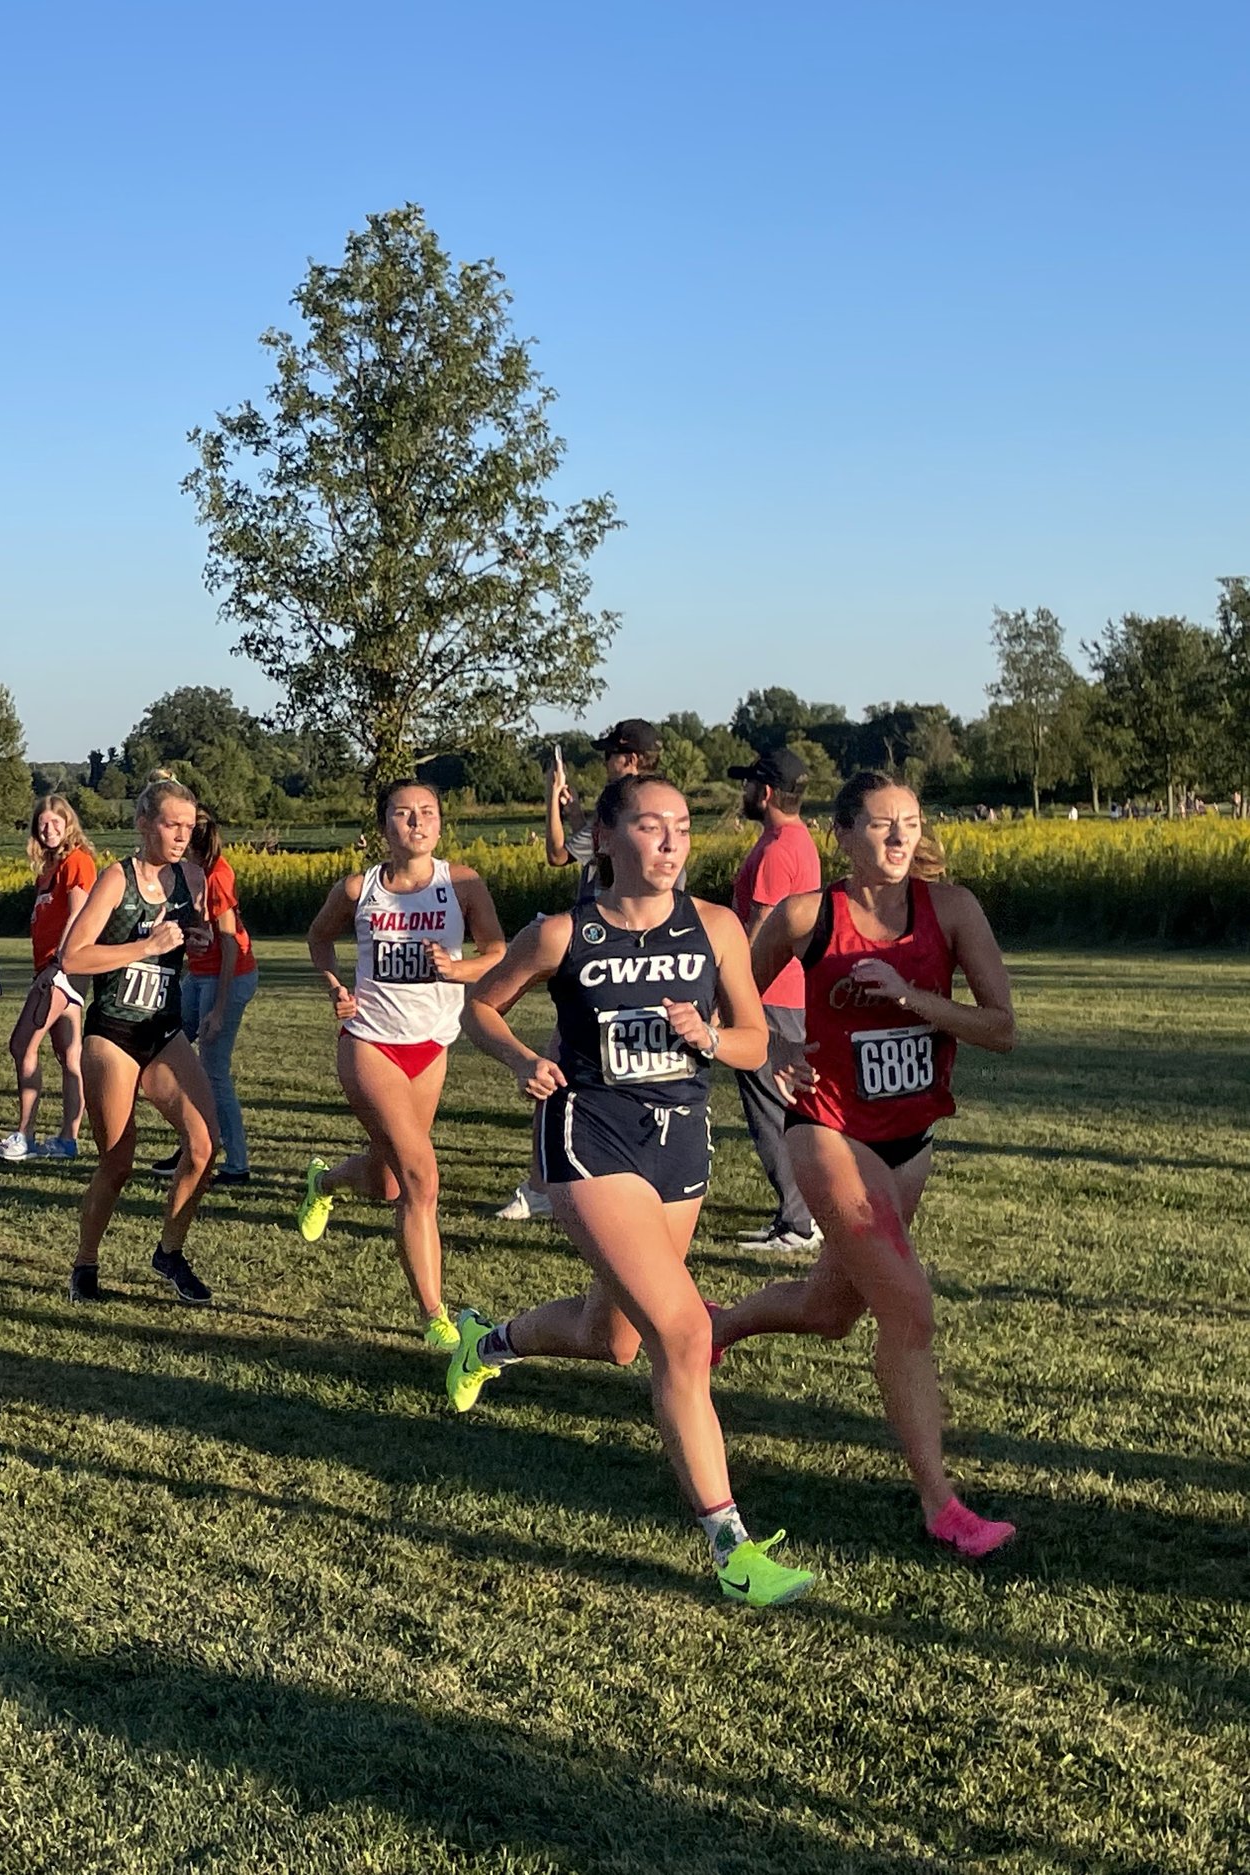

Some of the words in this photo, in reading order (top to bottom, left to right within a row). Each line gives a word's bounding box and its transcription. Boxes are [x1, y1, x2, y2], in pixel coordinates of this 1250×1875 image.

[436, 887, 448, 903] C
[369, 911, 447, 931] MALONE
[579, 954, 707, 988] CWRU
[123, 967, 170, 1010] 7175
[860, 1035, 935, 1094] 6883
